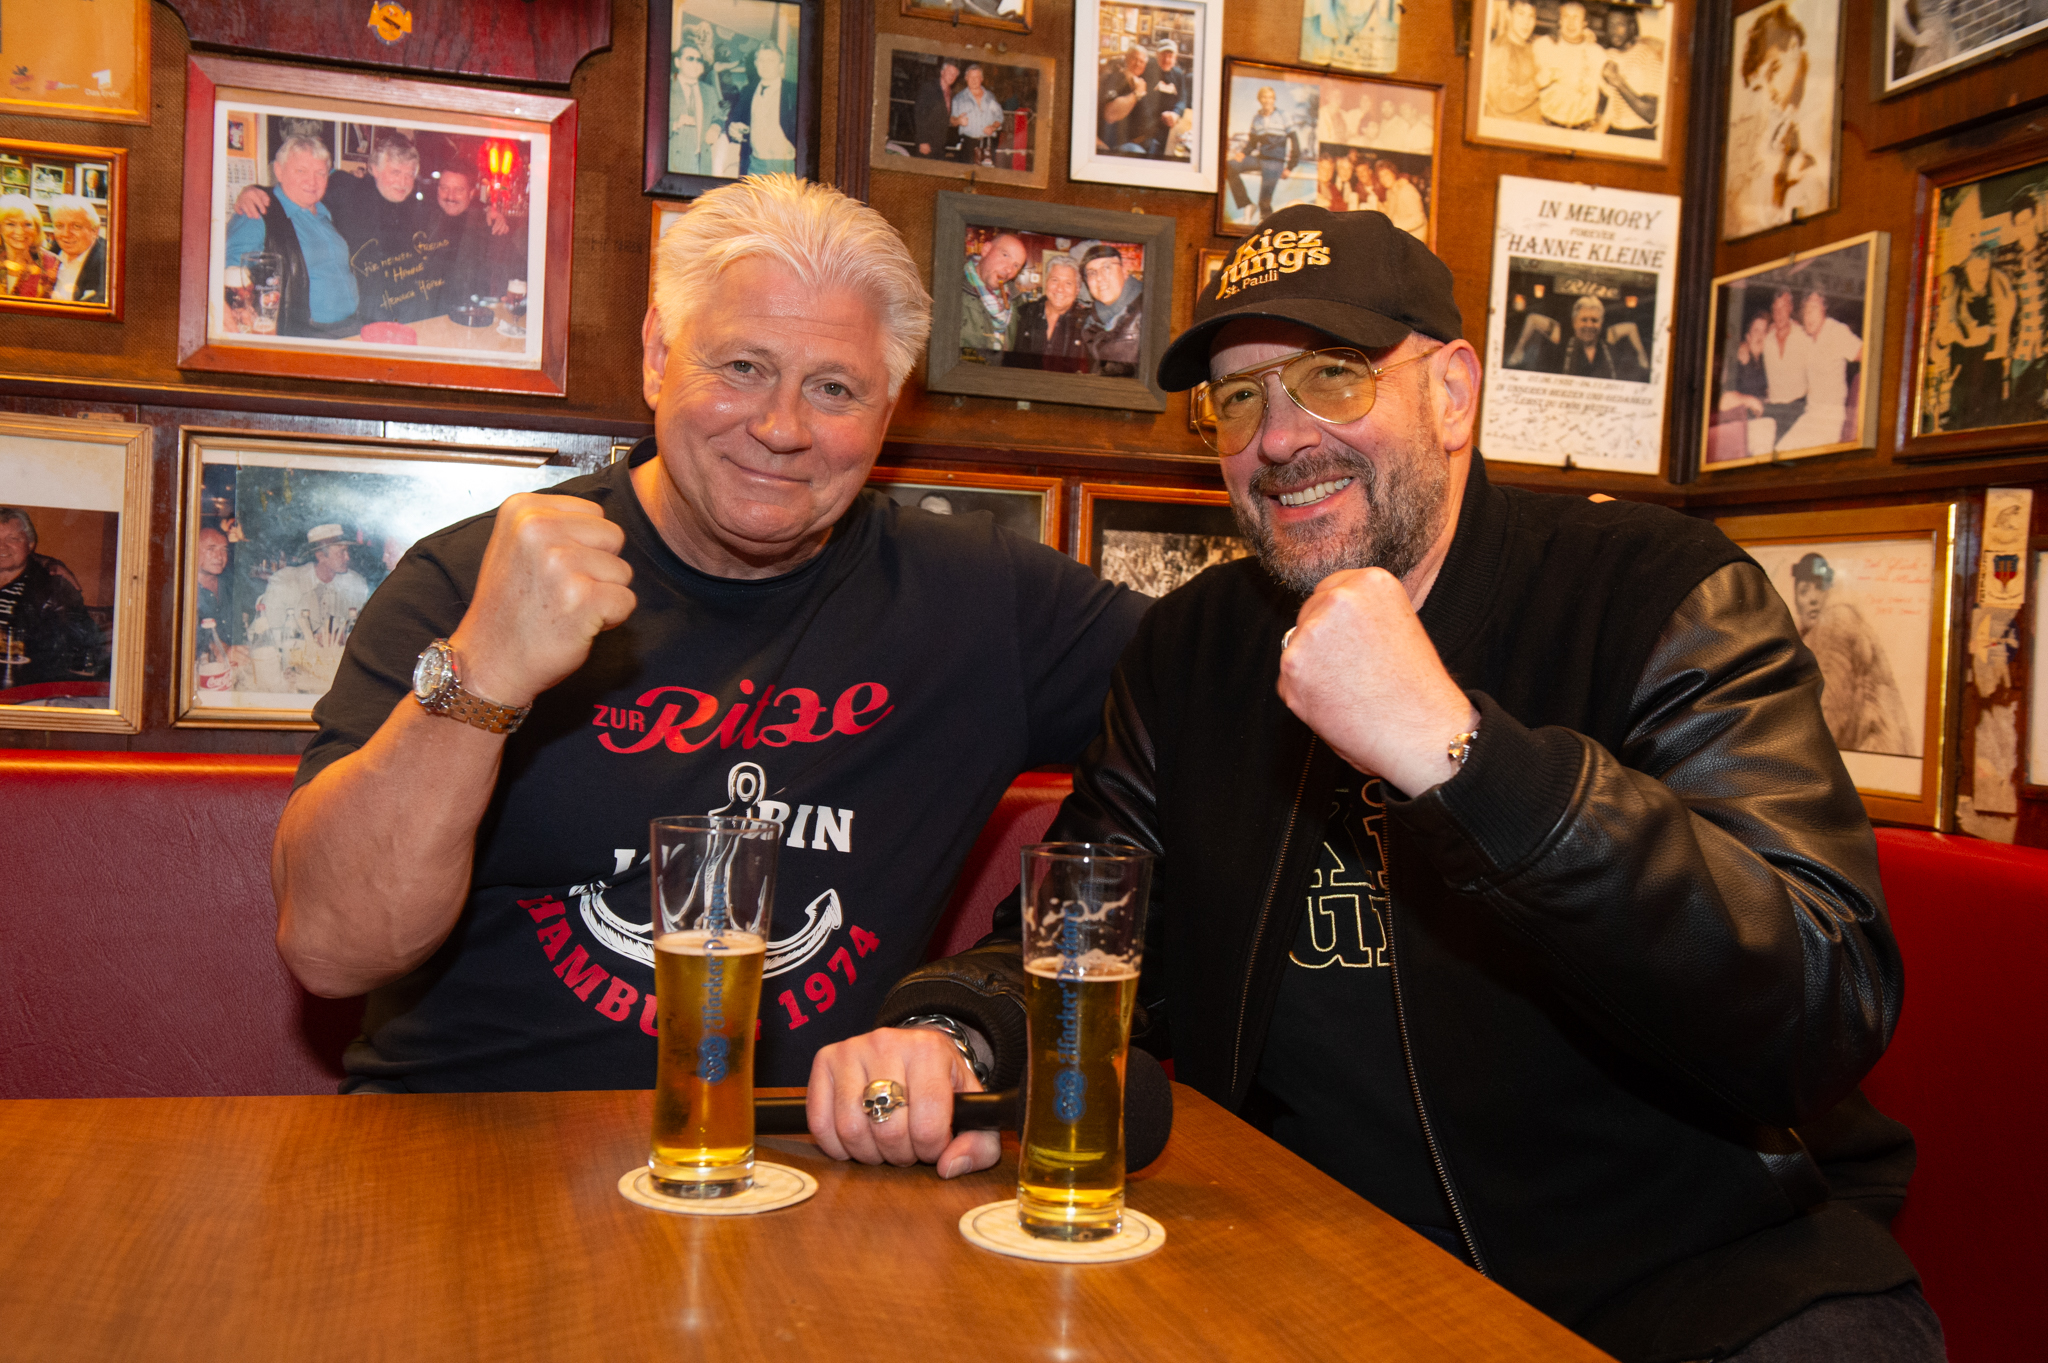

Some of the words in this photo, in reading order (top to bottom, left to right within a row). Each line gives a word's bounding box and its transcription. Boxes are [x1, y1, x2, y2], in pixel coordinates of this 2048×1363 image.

[1538, 199, 1562, 219] IN
[1564, 203, 1662, 231] MEMORY
[1233, 228, 1323, 265] Kiez
[1508, 234, 1584, 259] HANNE
[1587, 243, 1667, 269] KLEINE
[1216, 246, 1332, 300] Jungs
[1224, 284, 1241, 299] St.
[1242, 269, 1279, 290] Pauli
[592, 704, 645, 732] ZUR
[597, 678, 895, 754] Ritze
[778, 924, 881, 1030] 1974
